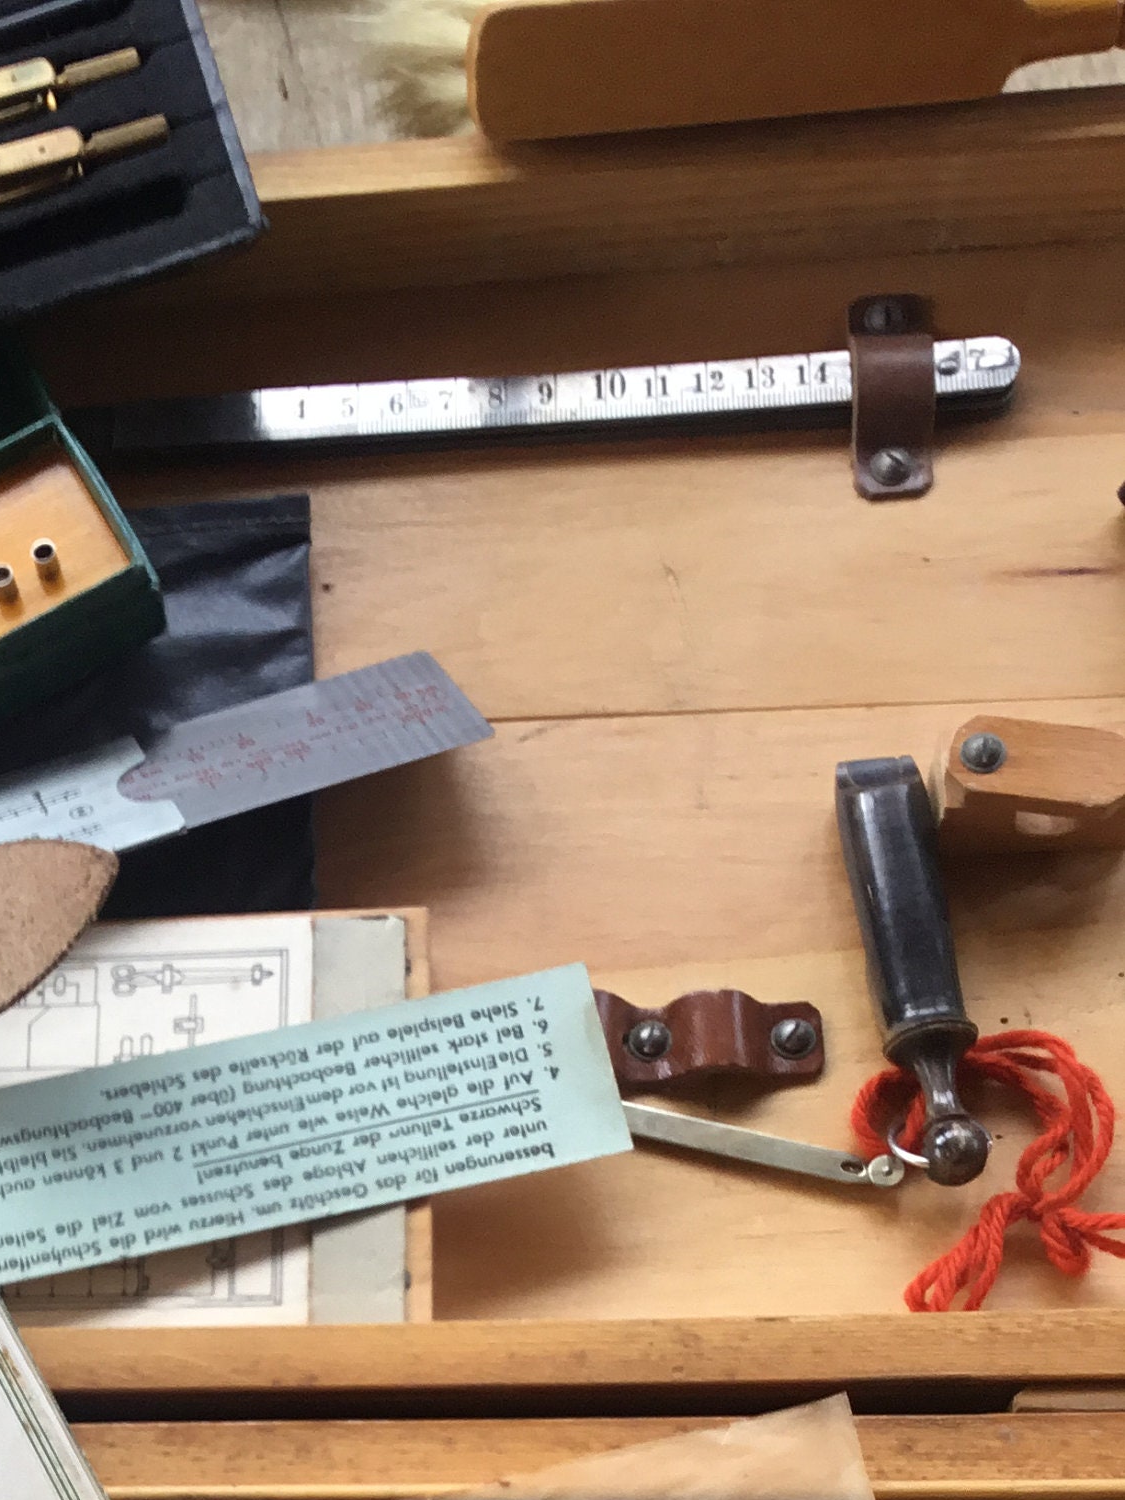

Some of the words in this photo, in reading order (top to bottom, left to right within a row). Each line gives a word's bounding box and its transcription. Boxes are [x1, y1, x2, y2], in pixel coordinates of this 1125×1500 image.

[388, 392, 403, 416] 6
[438, 389, 453, 411] 7
[488, 386, 503, 410] 8
[538, 381, 554, 406] 9
[590, 371, 627, 401] 10
[643, 373, 670, 398] 11
[693, 369, 725, 395] 12
[746, 365, 776, 391] 13
[798, 360, 828, 385] 14
[468, 999, 519, 1026] Siehe
[525, 993, 544, 1013] 7.
[384, 1009, 464, 1044] Beispiele
[494, 1022, 524, 1044] Bei
[531, 1017, 549, 1036] 6.
[313, 1037, 345, 1060] der
[350, 1029, 381, 1051] auf
[445, 1030, 489, 1055] stark
[535, 1039, 553, 1058] 5.
[226, 1044, 309, 1080] Rückseite
[361, 1040, 439, 1073] seitlicher
[191, 1063, 223, 1086] des
[241, 1057, 356, 1100] Beobachtung
[501, 1068, 535, 1090] Auf
[541, 1062, 561, 1081] 4.
[97, 1071, 187, 1107] Schiebers.
[344, 1078, 378, 1098] vor
[379, 1074, 400, 1094] ist
[465, 1077, 496, 1098] die
[187, 1082, 238, 1111] (über
[394, 1083, 460, 1114] gleiche
[333, 1100, 390, 1127] Weise
[457, 1094, 543, 1130] Schwarze
[243, 1121, 292, 1145] unter
[296, 1114, 329, 1135] wie
[502, 1117, 548, 1142] unter
[188, 1132, 239, 1159] Punkt
[287, 1135, 346, 1165] Zunge
[350, 1129, 383, 1152] der
[464, 1129, 497, 1153] der
[51, 1144, 78, 1165] Sie
[128, 1148, 165, 1171] und
[170, 1144, 183, 1162] 2
[376, 1137, 458, 1172] seitlichen
[443, 1137, 555, 1181] besserungen
[40, 1161, 107, 1191] können
[111, 1157, 125, 1175] 3
[300, 1153, 368, 1187] Ablage
[413, 1165, 439, 1188] für
[260, 1172, 295, 1195] des
[373, 1172, 409, 1196] das
[179, 1181, 255, 1213] Schusses
[250, 1199, 283, 1218] um.
[288, 1180, 369, 1213] Geschütz
[90, 1209, 125, 1233] Ziel
[132, 1199, 172, 1219] vom
[187, 1207, 245, 1235] Hierzu
[53, 1218, 84, 1240] die
[142, 1221, 183, 1245] wird
[107, 1231, 138, 1252] die
